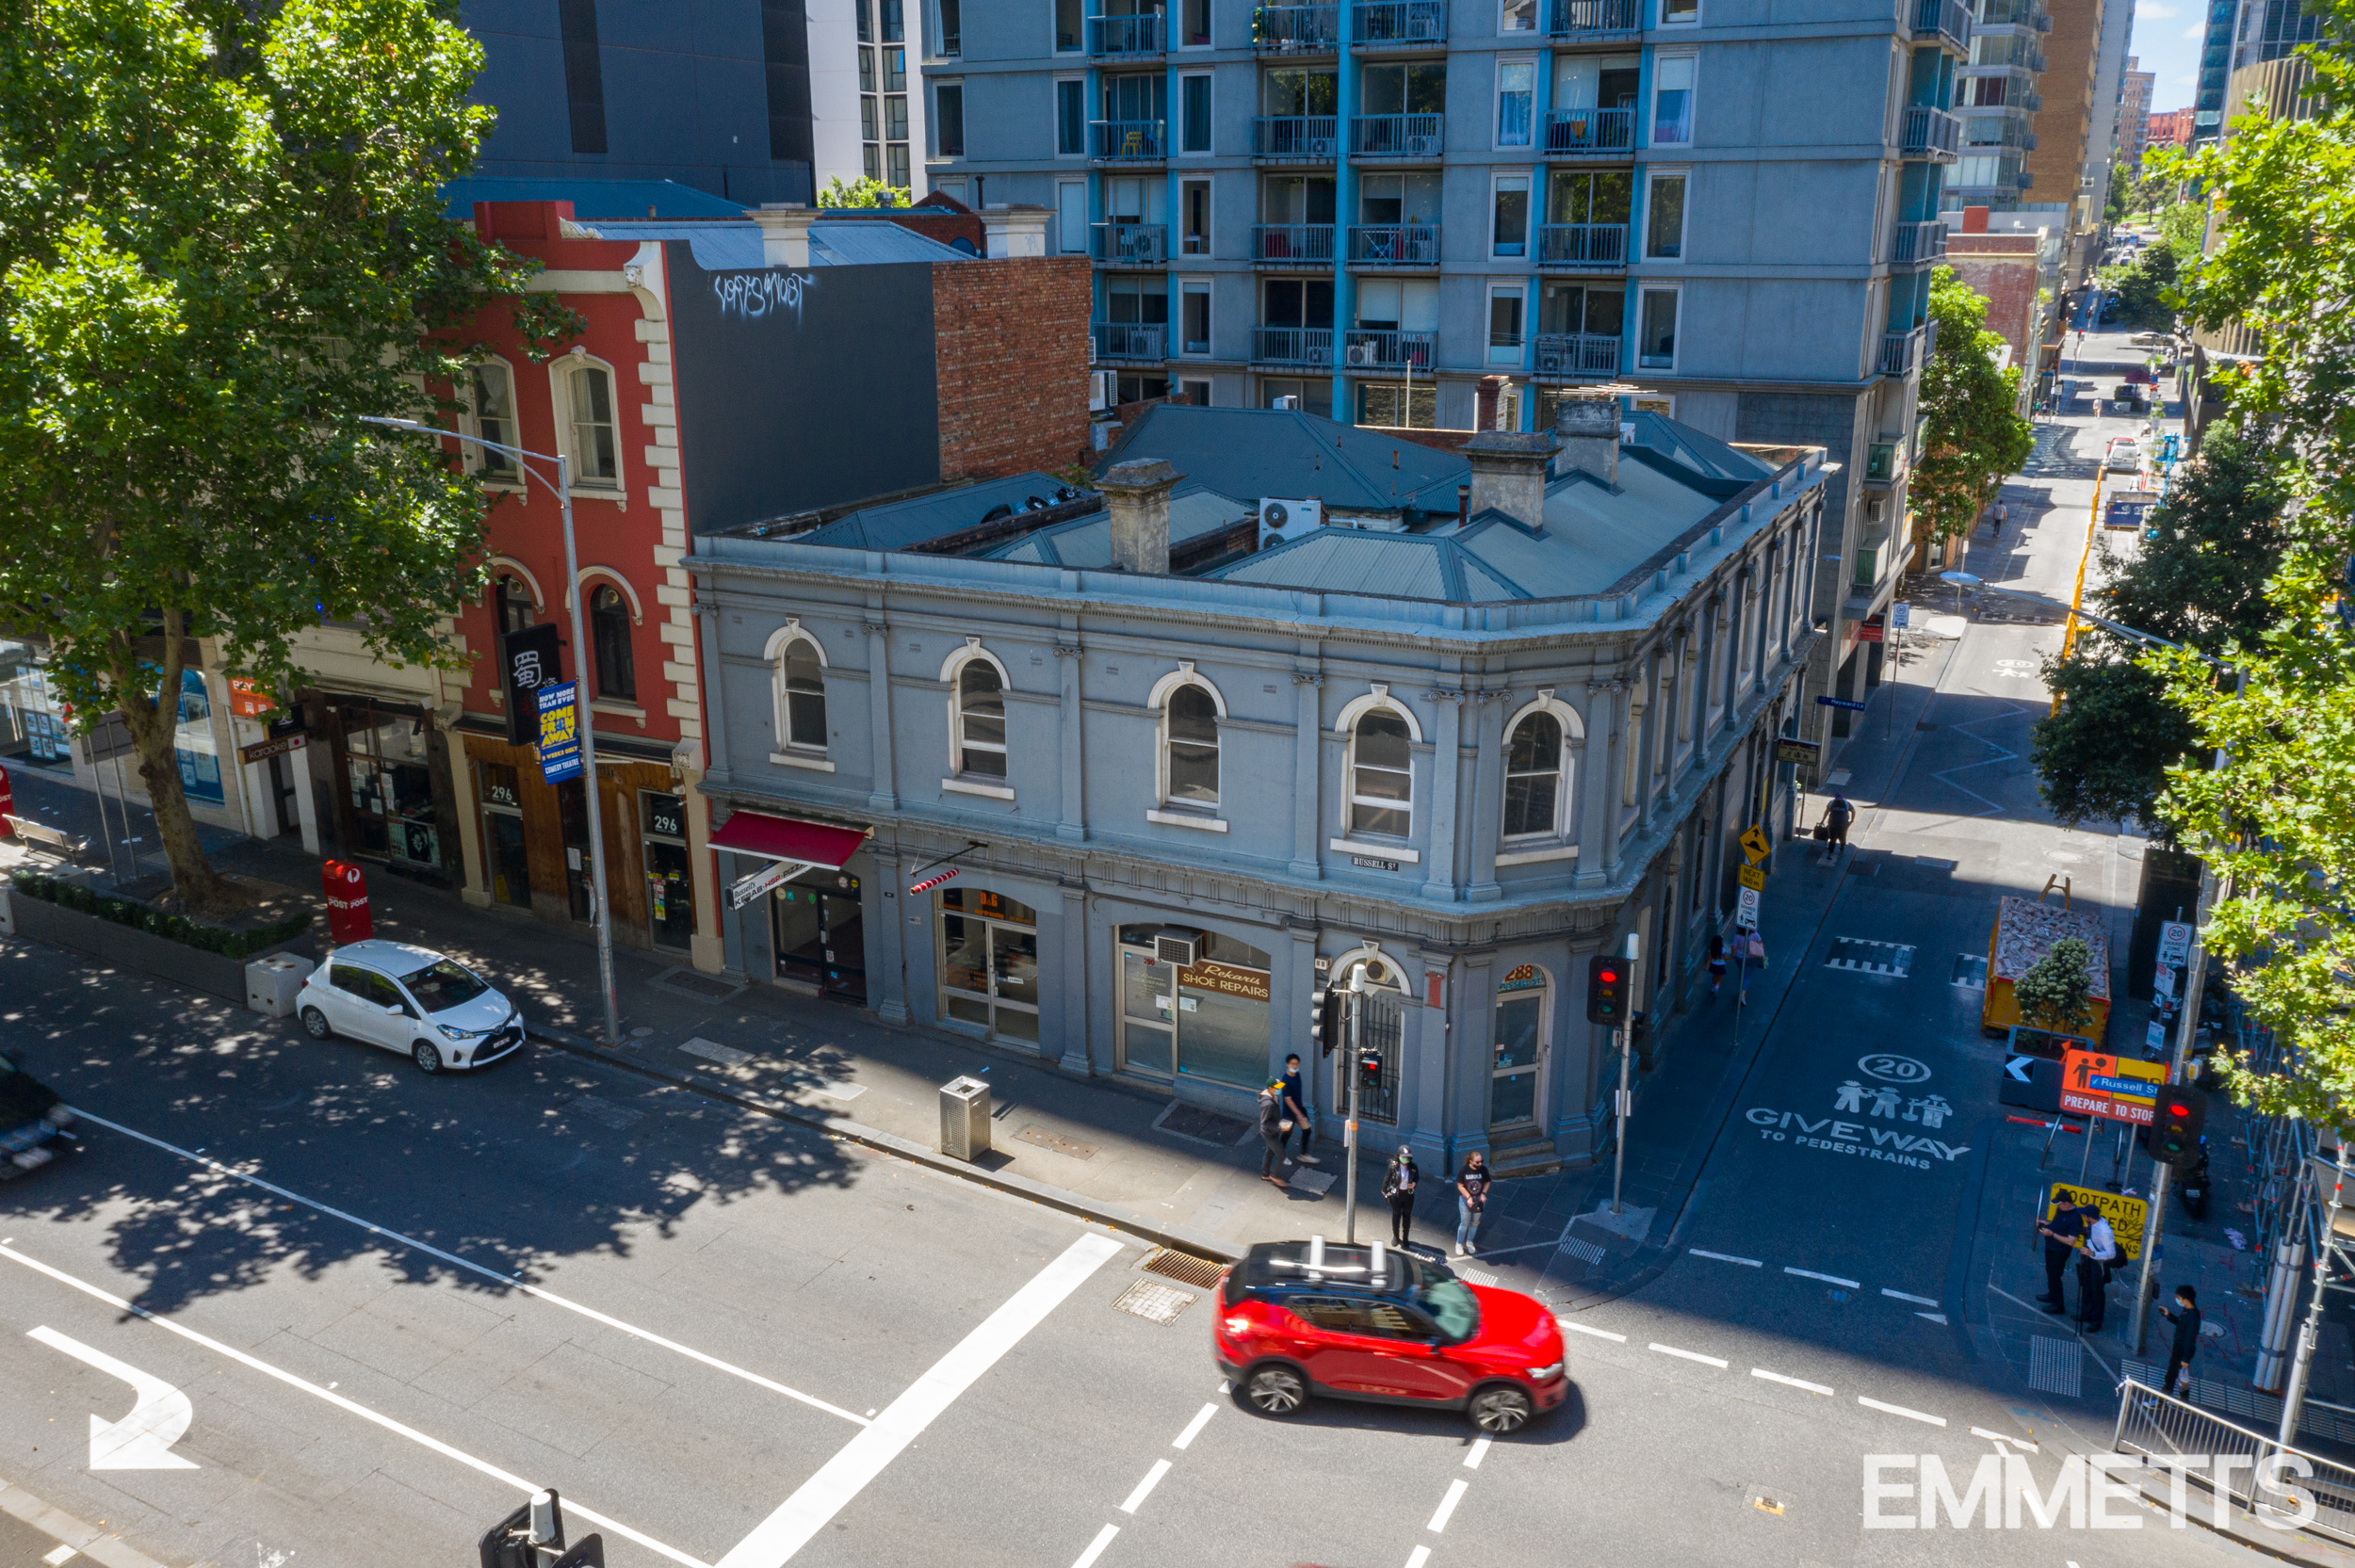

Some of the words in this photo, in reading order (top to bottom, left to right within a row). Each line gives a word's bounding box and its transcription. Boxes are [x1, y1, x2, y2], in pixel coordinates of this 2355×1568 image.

[512, 651, 542, 688] 蜀
[539, 692, 555, 703] NOW
[556, 687, 575, 697] MORE
[539, 699, 557, 709] THAN
[558, 694, 575, 704] EVER
[1830, 699, 1856, 708] Hayward
[540, 704, 575, 724] COME
[542, 726, 576, 747] AWAY
[249, 741, 287, 759] karaoke
[546, 750, 564, 760] WEEKS
[565, 746, 577, 754] ONLY
[545, 762, 562, 774] COMEDY
[562, 758, 579, 769] THEATRE
[492, 785, 512, 800] 296
[655, 816, 677, 832] 296
[1354, 857, 1386, 869] RUSSELL
[764, 874, 780, 888] HSP
[1744, 867, 1761, 879] NEXT
[735, 881, 755, 897] Russell's
[328, 897, 348, 910] POST
[350, 896, 368, 909] POST
[980, 891, 998, 908] D&G
[1745, 894, 1753, 902] 20
[2170, 929, 2183, 938] 20
[1143, 958, 1155, 966] 290
[1204, 964, 1260, 985] Rekaris
[1504, 964, 1533, 981] 288
[1183, 973, 1215, 987] SHOE
[1220, 980, 1269, 998] REPAIRS
[1499, 979, 1531, 989] RUSSELL
[1873, 1058, 1917, 1077] 20
[2101, 1077, 2142, 1091] Russell
[2064, 1094, 2109, 1113] PREPARE
[2115, 1104, 2127, 1117] TO
[1746, 1107, 1865, 1142] GIVE
[1869, 1126, 1972, 1161] WAY
[1760, 1129, 1786, 1141] TO
[2059, 1188, 2141, 1217] OOTPATH
